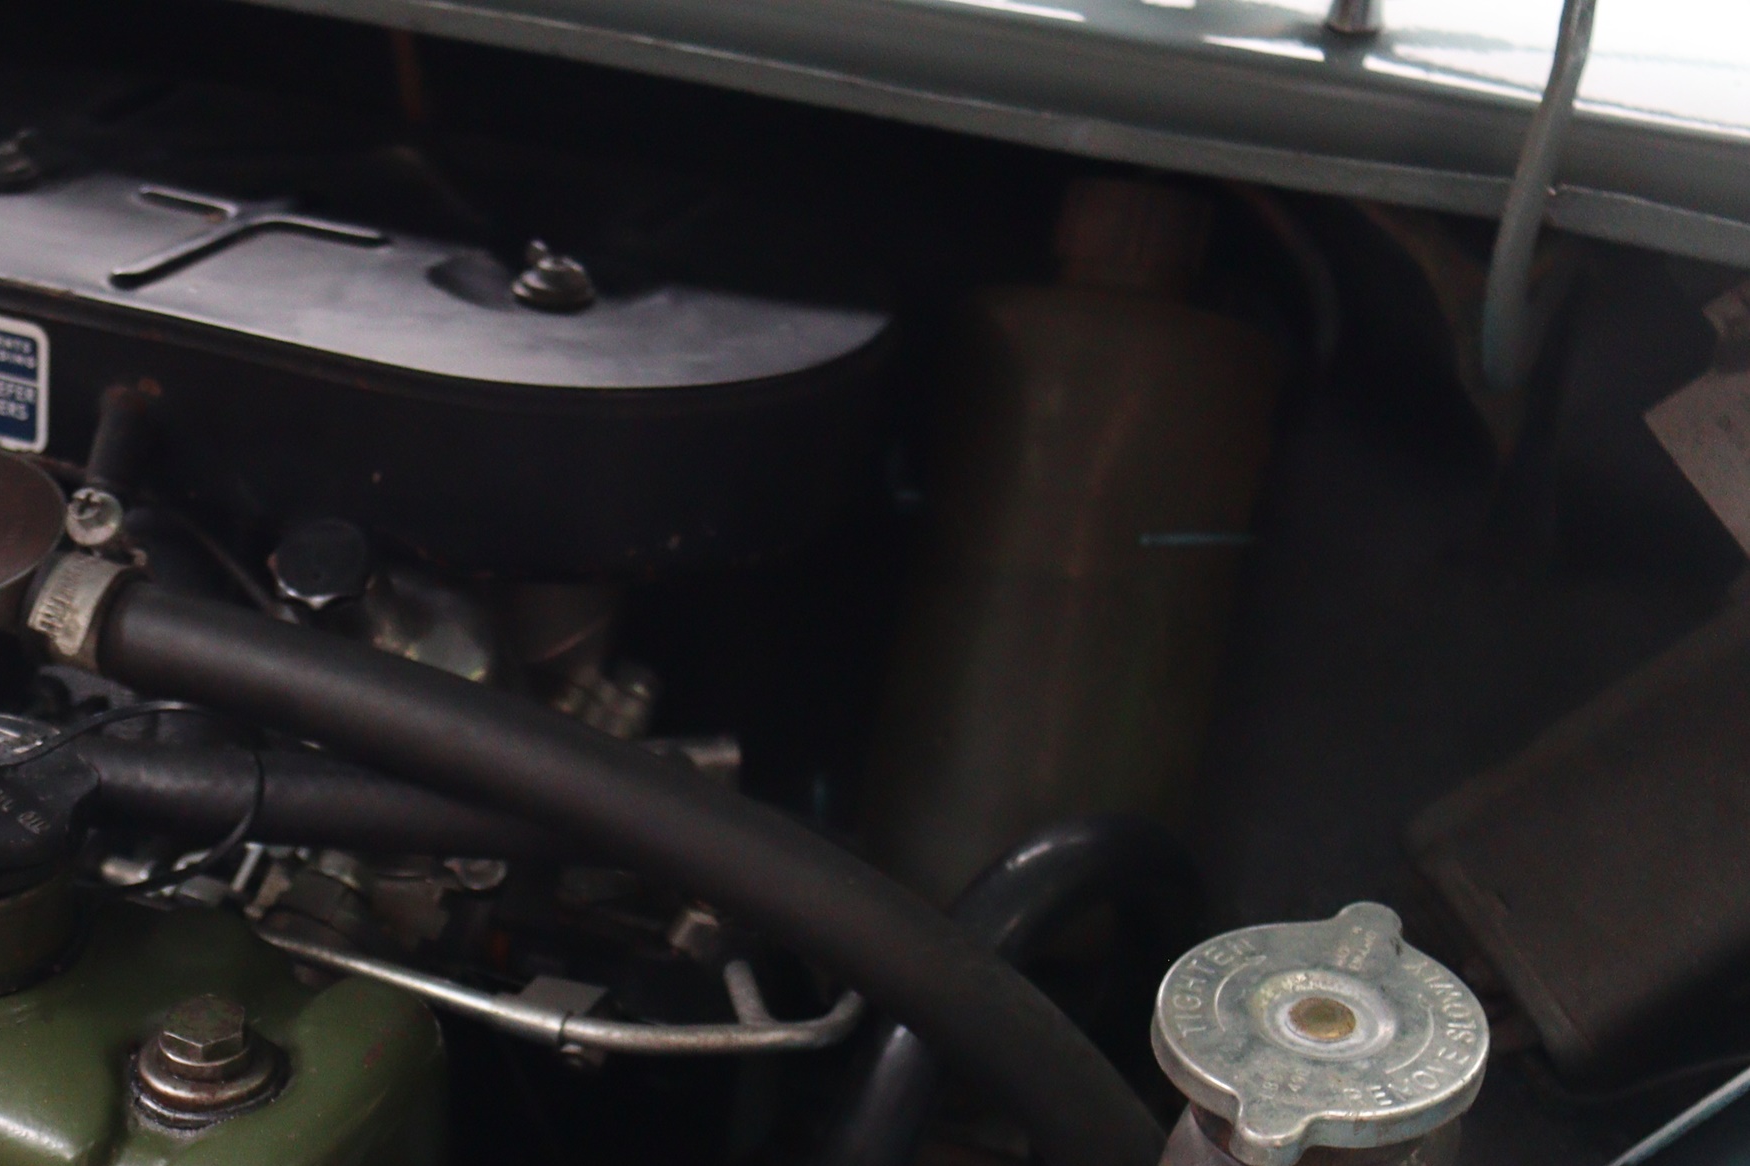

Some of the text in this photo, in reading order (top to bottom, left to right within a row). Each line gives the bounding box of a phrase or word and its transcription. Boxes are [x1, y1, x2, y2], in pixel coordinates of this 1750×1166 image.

[1171, 937, 1258, 1040] TIGHTEN
[1402, 960, 1479, 1046] SLOWLY
[1342, 1045, 1472, 1108] REMOVE
